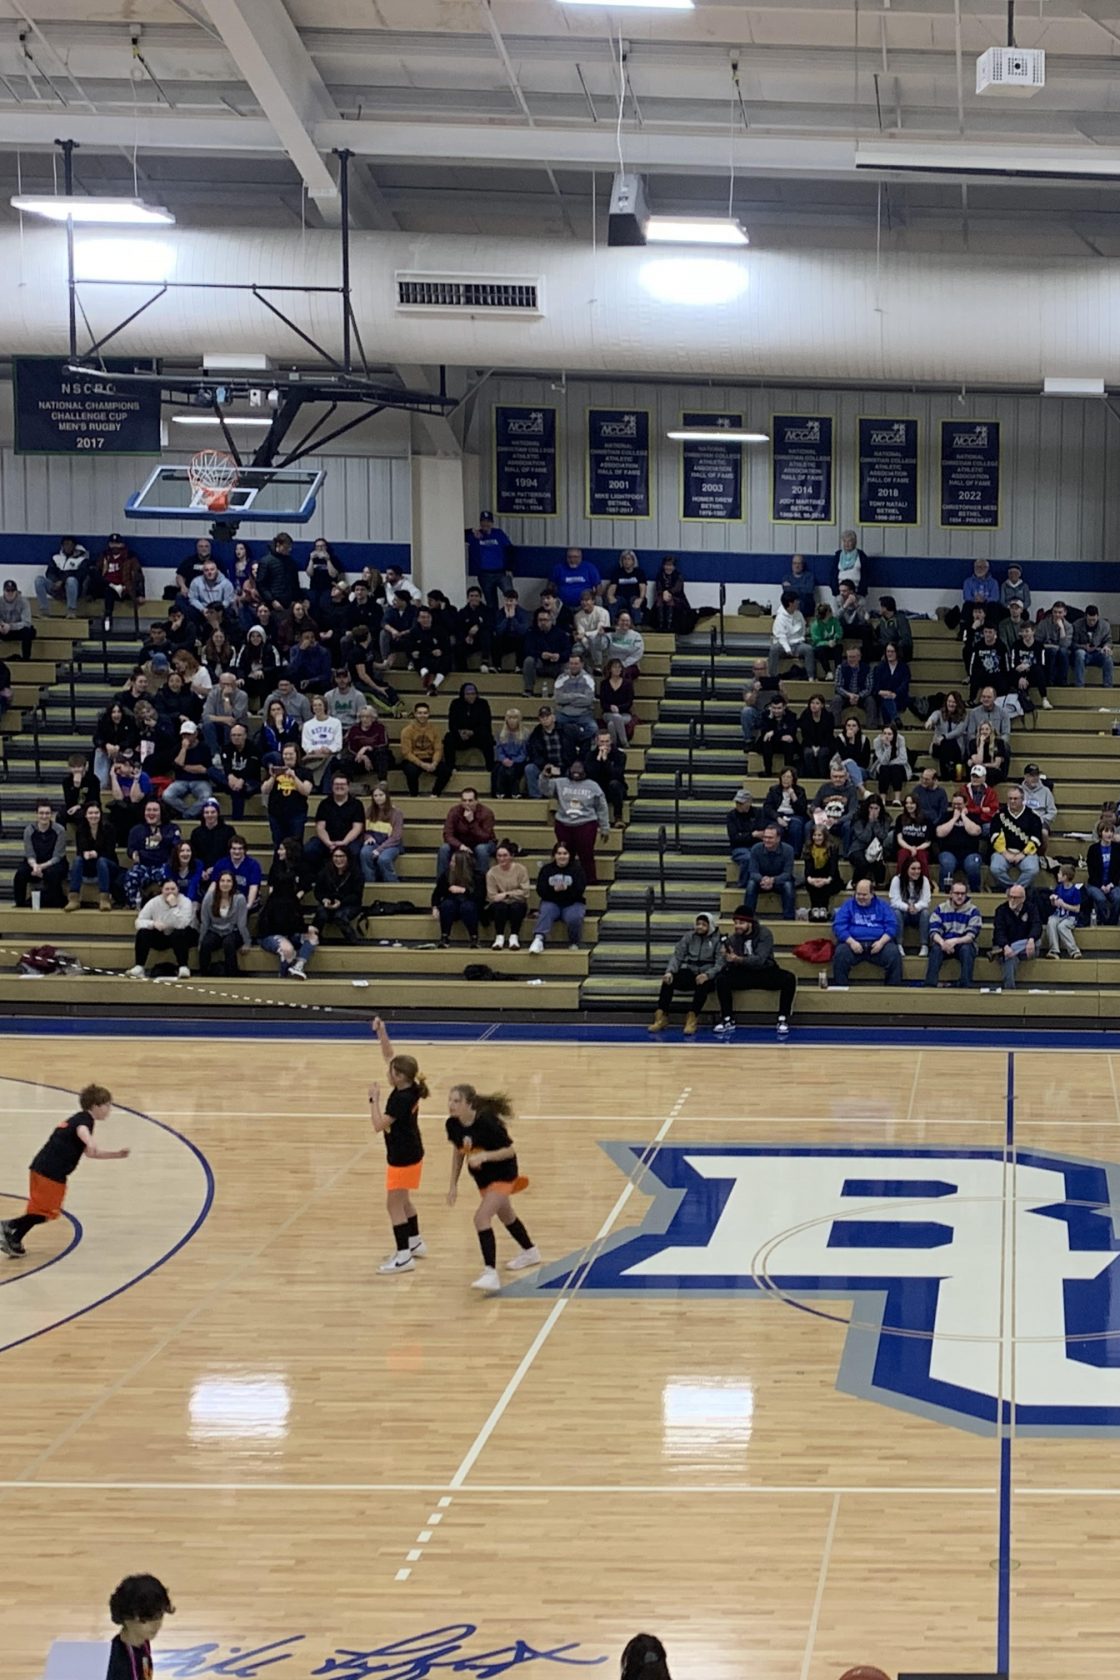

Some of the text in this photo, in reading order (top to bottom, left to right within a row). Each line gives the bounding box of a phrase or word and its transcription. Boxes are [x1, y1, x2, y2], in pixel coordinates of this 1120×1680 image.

[38, 401, 140, 410] NATIONAL CHAMPIONS
[51, 412, 128, 421] CHALLENGE CUP
[58, 422, 122, 432] MEN'S RUGBY
[76, 437, 105, 449] 2017
[609, 481, 629, 489] 2001
[702, 484, 723, 492] 2003
[792, 486, 813, 494] 2014
[878, 489, 898, 497] 2018
[958, 491, 981, 500] 2022
